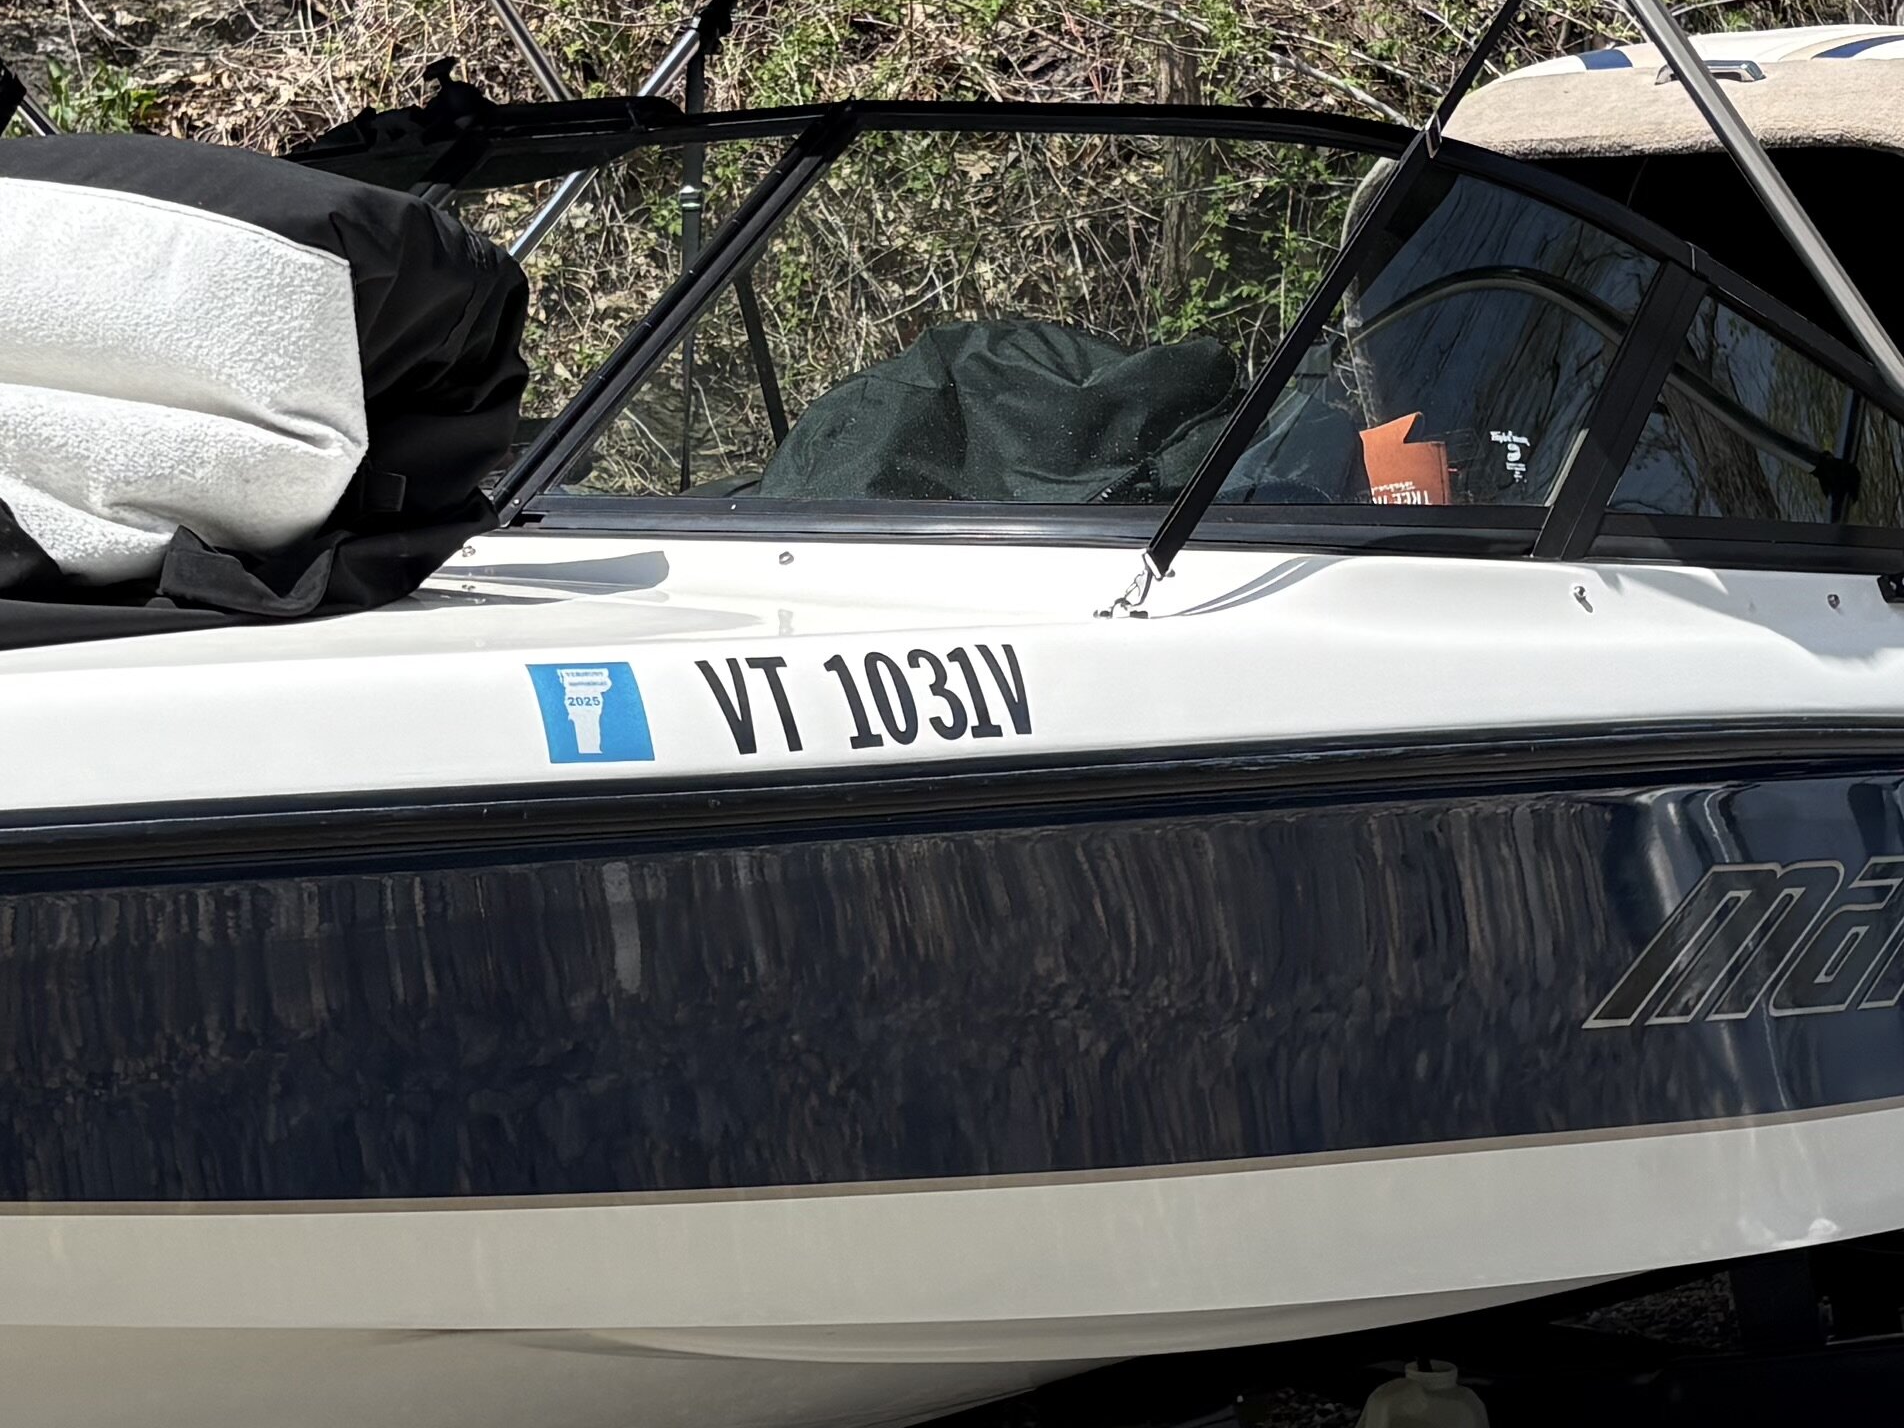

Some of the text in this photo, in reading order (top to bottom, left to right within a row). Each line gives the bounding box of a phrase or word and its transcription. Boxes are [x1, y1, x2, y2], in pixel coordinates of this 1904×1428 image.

[567, 696, 601, 706] 2025
[694, 644, 1032, 755] VT 1031V
